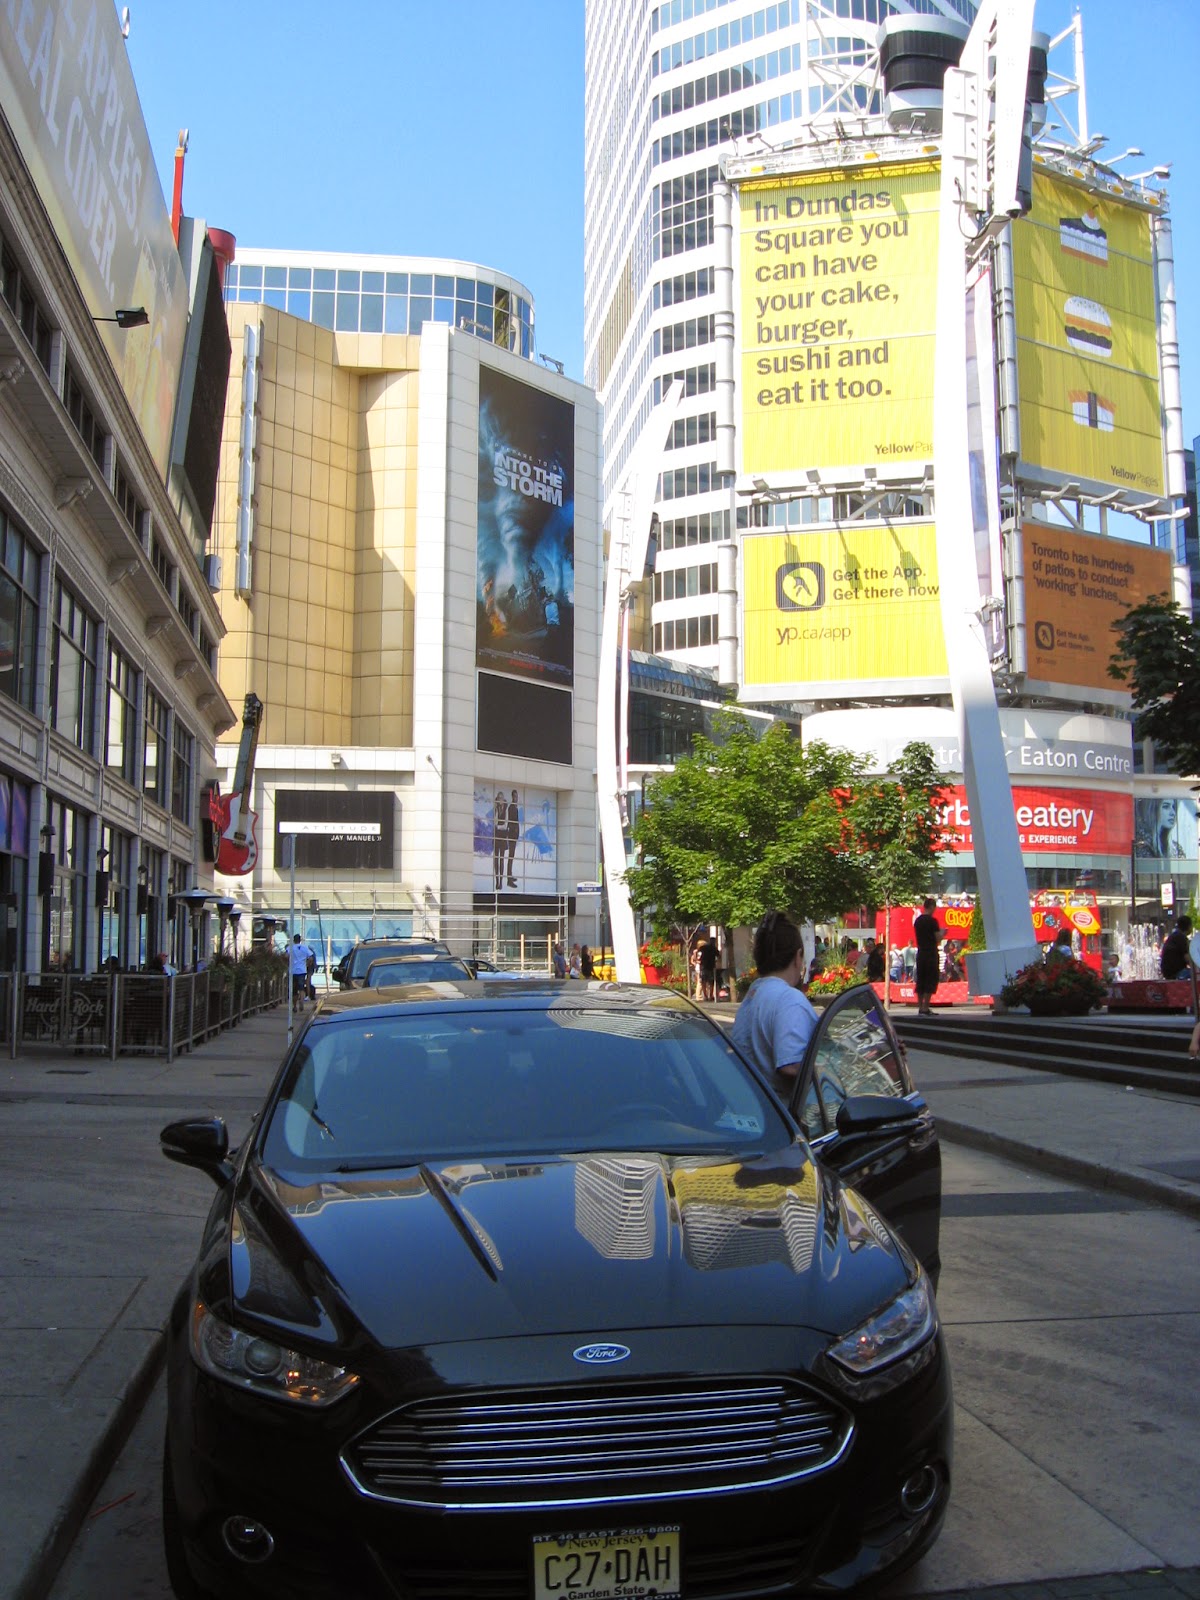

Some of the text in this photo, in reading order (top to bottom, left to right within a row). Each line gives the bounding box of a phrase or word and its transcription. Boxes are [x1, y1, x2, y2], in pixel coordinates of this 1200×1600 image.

[64, 96, 116, 302] CIDER.
[755, 189, 891, 222] In Dundas
[754, 219, 909, 255] Square you
[755, 253, 878, 283] can have
[755, 281, 899, 319] your cake,
[757, 318, 854, 345] burger,
[757, 341, 889, 375] sushi and
[757, 377, 892, 407] eat it too.
[494, 451, 563, 490] INTO THE
[493, 466, 563, 507] STORM
[833, 565, 927, 581] Get the App.
[1032, 542, 1134, 575] Toronto has hundreds
[1032, 559, 1128, 588] of patios to conduct
[833, 588, 860, 600] Get
[864, 586, 903, 599] there
[776, 626, 851, 645] yp.ca/app
[1020, 745, 1078, 768] Eaton
[1083, 750, 1131, 774] Centre
[1016, 805, 1094, 835] eatery
[346, 834, 376, 842] MANUEL
[1028, 834, 1078, 845] EXPERIENCE
[25, 997, 105, 1016] Hard Rock
[586, 1346, 617, 1359] Ford
[568, 1534, 645, 1549] New Jersey
[578, 1529, 617, 1538] EAST
[568, 1589, 610, 1600] Garden
[614, 1585, 645, 1596] State
